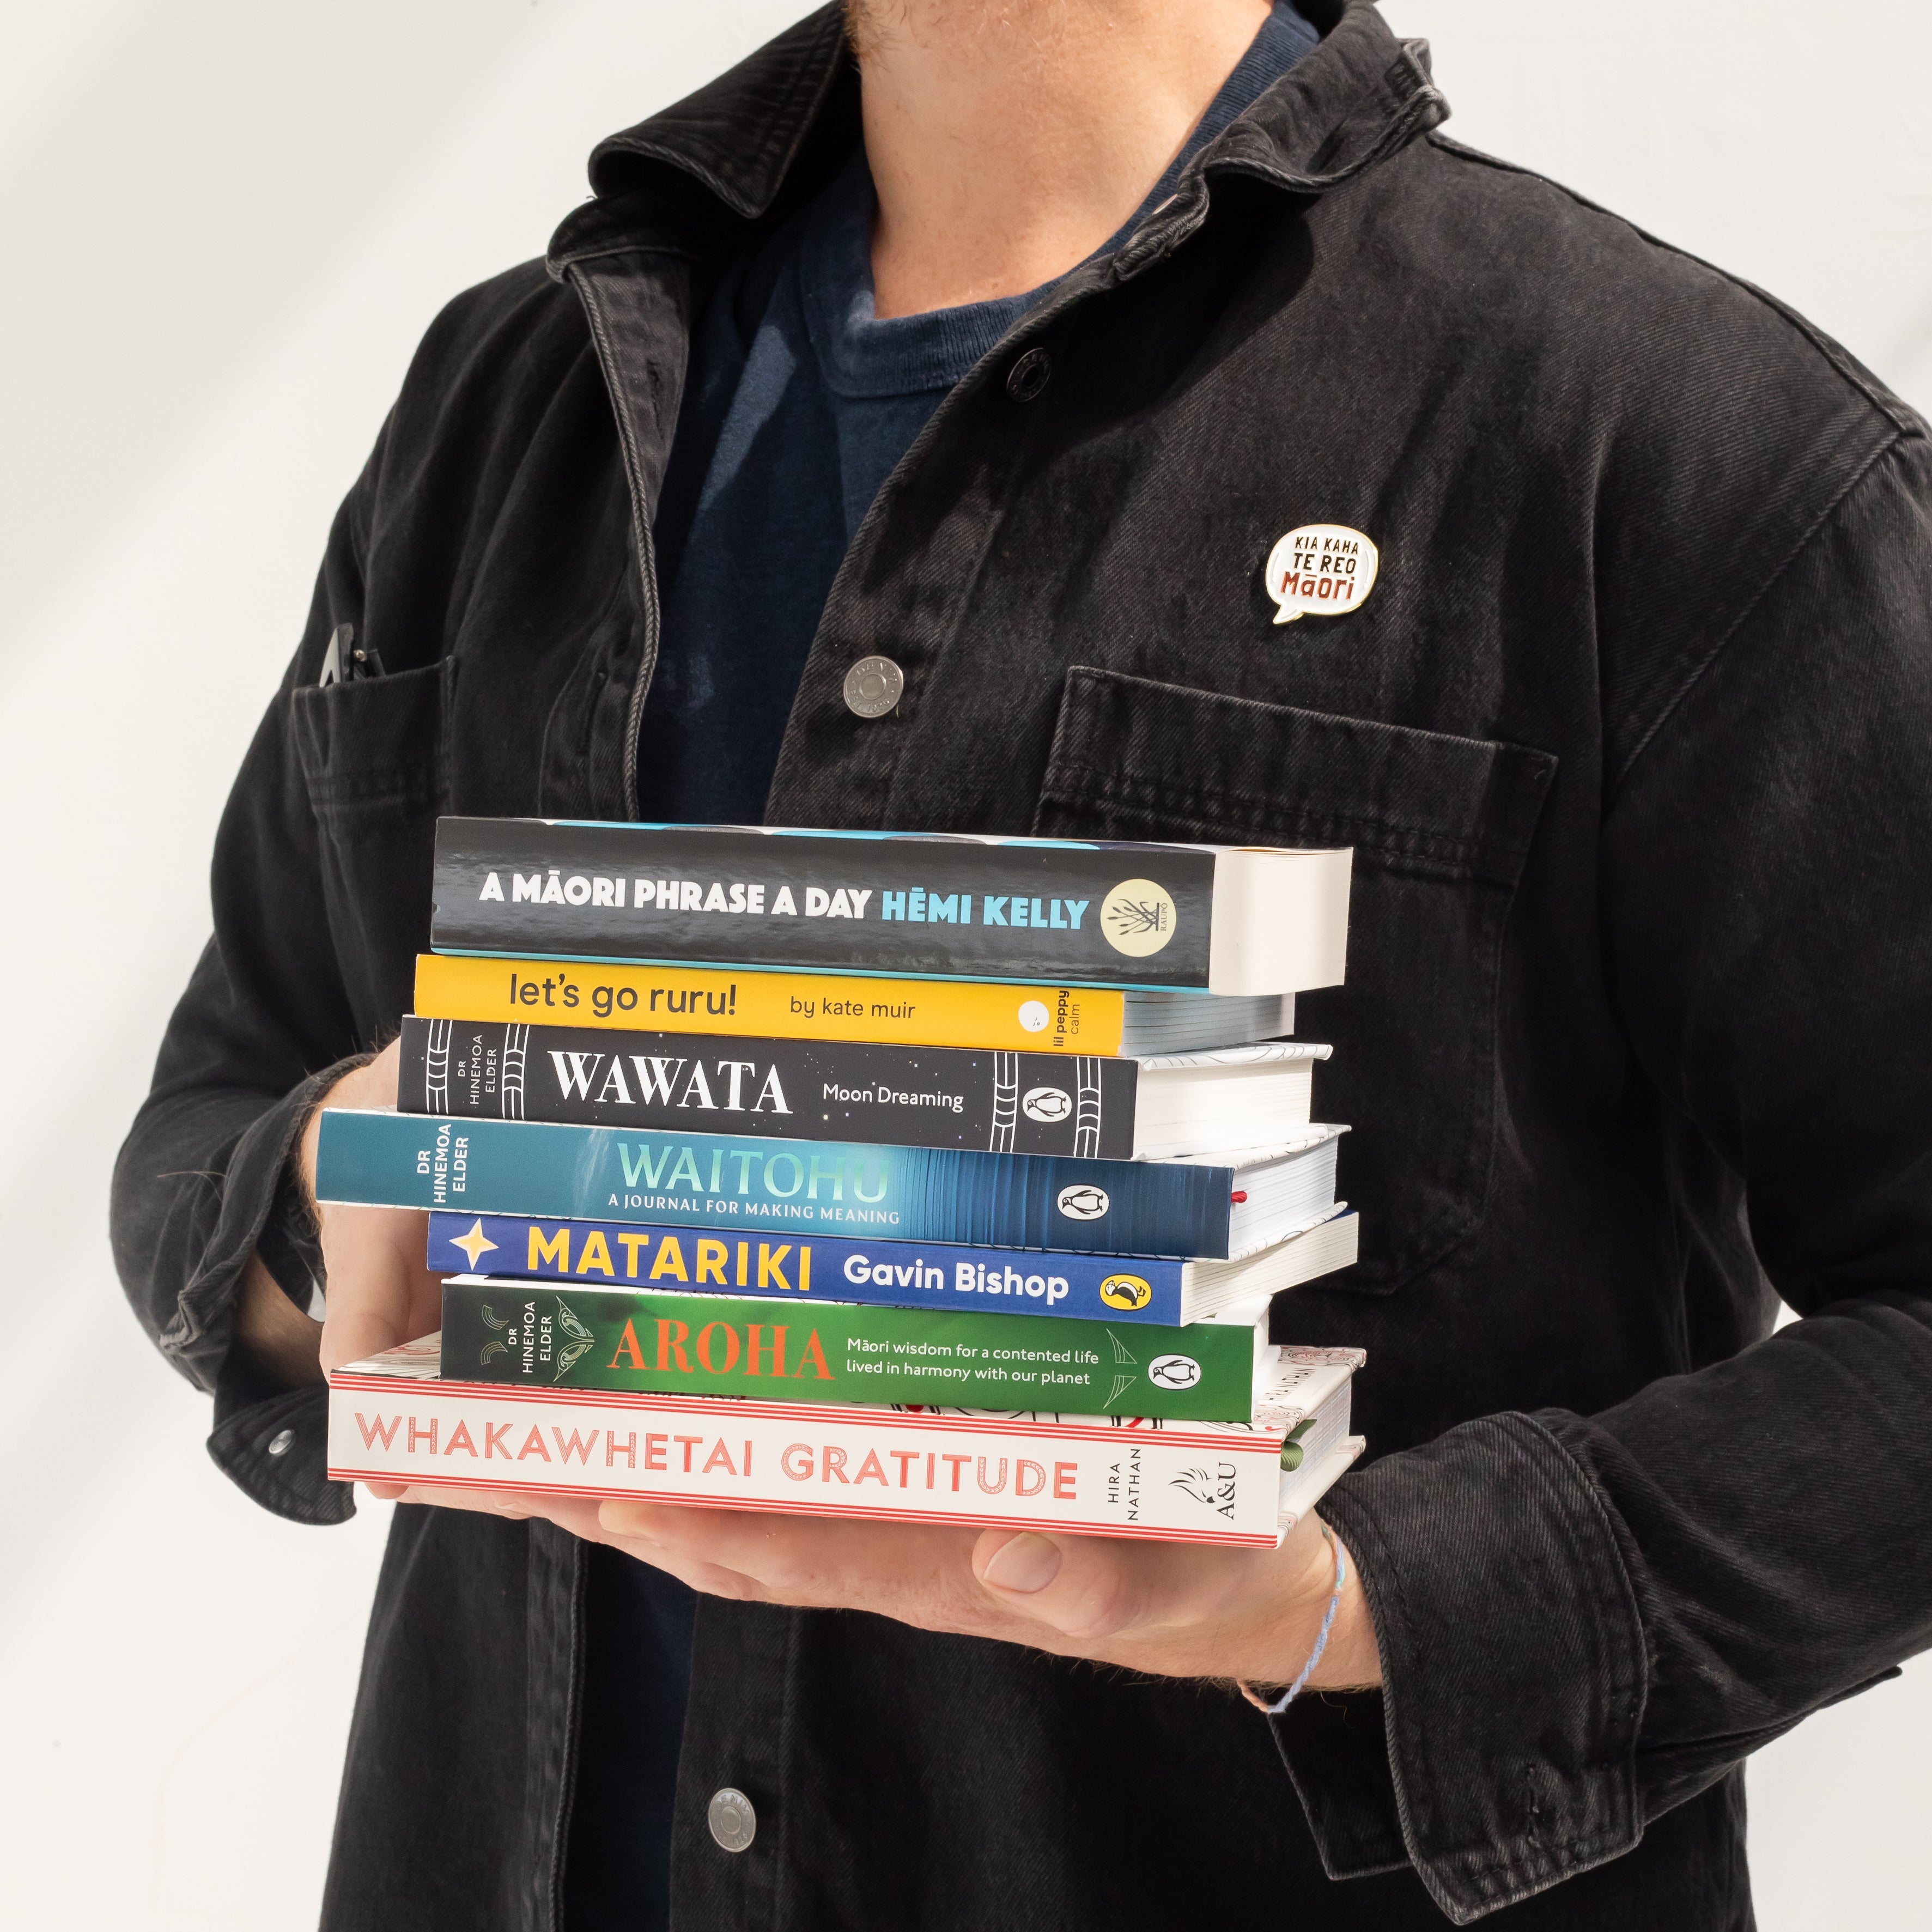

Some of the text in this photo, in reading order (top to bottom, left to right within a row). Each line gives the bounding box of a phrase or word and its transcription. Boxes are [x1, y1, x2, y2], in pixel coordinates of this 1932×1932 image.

[1293, 552, 1356, 574] TE REO
[1295, 537, 1358, 555] KIA KAHA
[1280, 571, 1354, 600] Māori
[479, 870, 1090, 930] A MĀORI PHRASE A DAY HĒMI KELLY
[592, 986, 638, 1018] go
[650, 984, 737, 1016] ruru!
[791, 996, 815, 1018] by
[823, 997, 864, 1017] kate
[872, 1002, 916, 1019] muir
[1053, 991, 1070, 1047] lil peppy
[1069, 1004, 1080, 1034] calm
[458, 1060, 466, 1077] DR
[470, 1035, 483, 1105] HINEMOA
[485, 1049, 497, 1093] ELDER
[547, 1050, 964, 1114] WAWATA Moon Dreaming
[417, 1149, 430, 1174] DR
[433, 1123, 452, 1204] HINEMOA
[453, 1137, 469, 1193] ELDER
[617, 1143, 890, 1202] WAITOHU
[609, 1193, 900, 1225] A JOURNAL FOR MAKING MEANING
[527, 1226, 1070, 1305] MATARIKI Gavin Bishop
[508, 1327, 517, 1345] DR
[523, 1301, 535, 1374] HINEMOA
[540, 1315, 552, 1362] ELDER
[606, 1317, 835, 1380] AROHA
[847, 1338, 1099, 1364] Māori wisdom for a contented life
[847, 1360, 1090, 1386] lived in harmony with our planet
[354, 1413, 1078, 1499] WHAKAWHETAI GRATITUDE
[1108, 1462, 1120, 1503] HIRA
[1127, 1448, 1140, 1520] NATHAN
[1216, 1461, 1236, 1520] A&U
